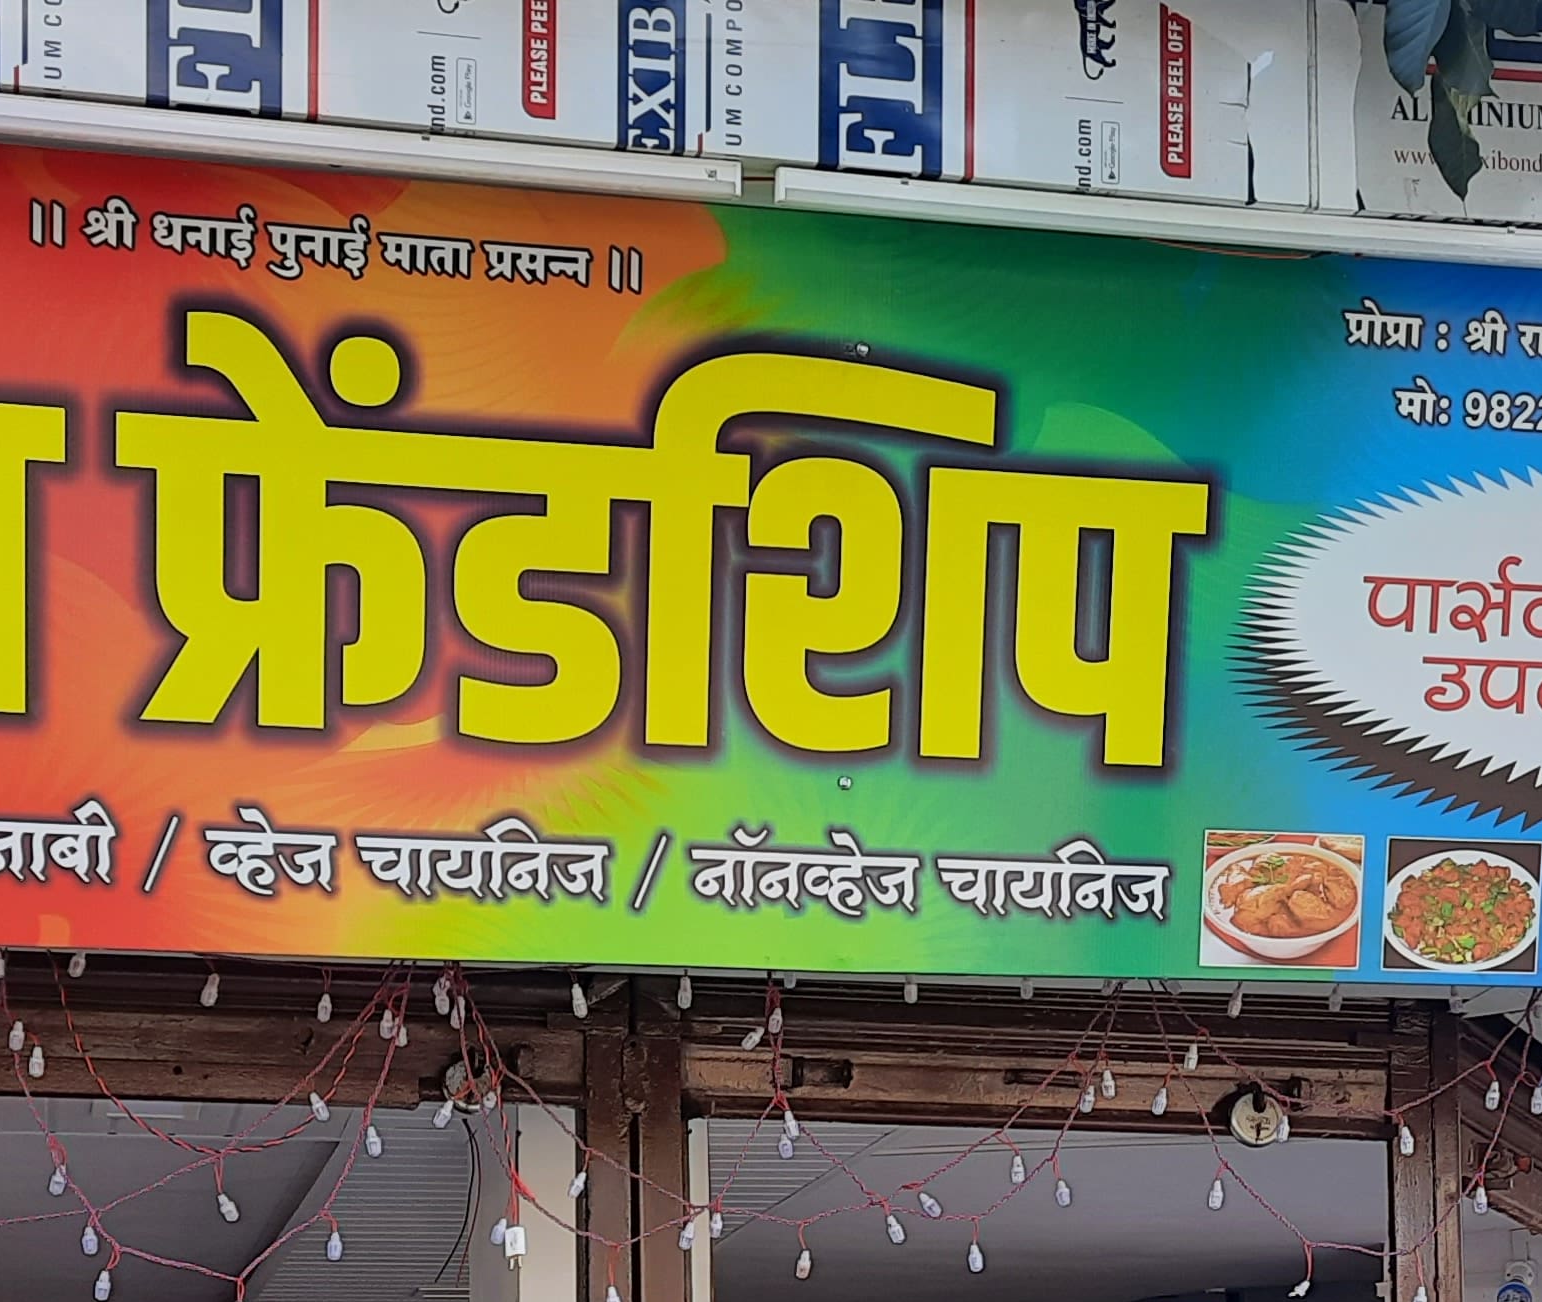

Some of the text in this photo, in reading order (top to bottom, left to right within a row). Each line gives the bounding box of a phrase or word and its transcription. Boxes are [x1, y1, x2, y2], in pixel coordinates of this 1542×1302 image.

[529, 37, 548, 104] PLEASE
[1168, 20, 1186, 164] PLEASE PEEL OFF
[83, 197, 136, 249] श्री
[154, 205, 255, 269] धनाई
[267, 218, 368, 278] पुनाई
[380, 233, 471, 278] माता
[484, 241, 591, 285] प्रसन्न
[1464, 309, 1508, 357] श्री
[114, 312, 1210, 767] फ्रेंडशिप
[205, 809, 336, 894] व्हेज
[354, 818, 610, 903] चायनिज
[689, 828, 921, 915] नॉनव्हेज
[934, 840, 1171, 921] चायनिज
